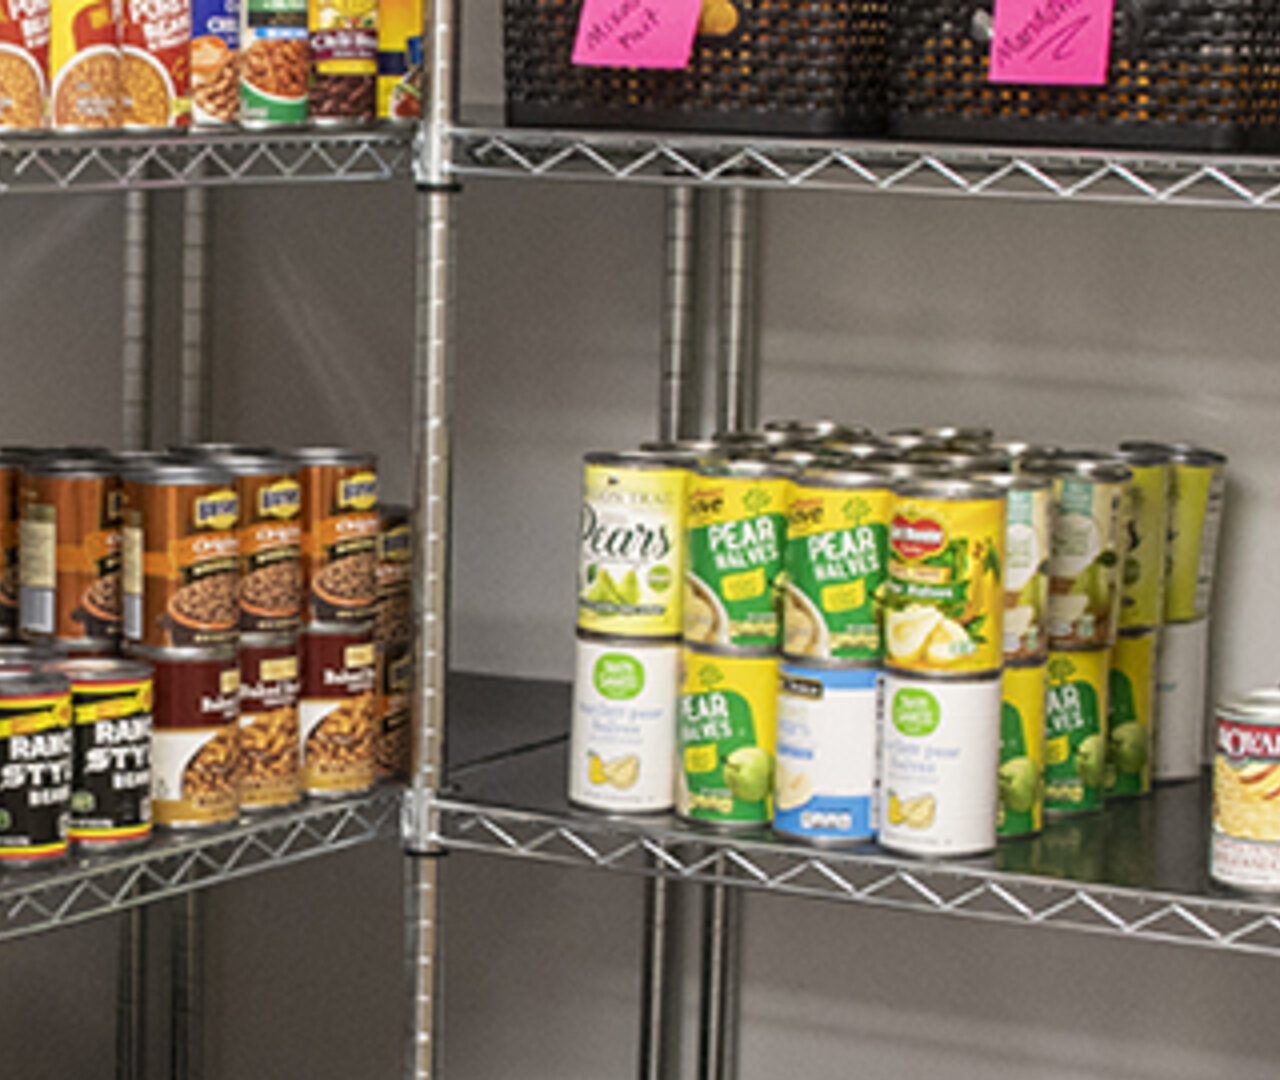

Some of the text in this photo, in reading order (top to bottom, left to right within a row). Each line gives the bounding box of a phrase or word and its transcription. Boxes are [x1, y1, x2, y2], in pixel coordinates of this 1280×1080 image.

[580, 505, 671, 560] Pears
[709, 516, 775, 553] PEAR
[808, 527, 877, 562] PEAR
[714, 543, 779, 571] HALVES
[813, 554, 880, 582] HALVES
